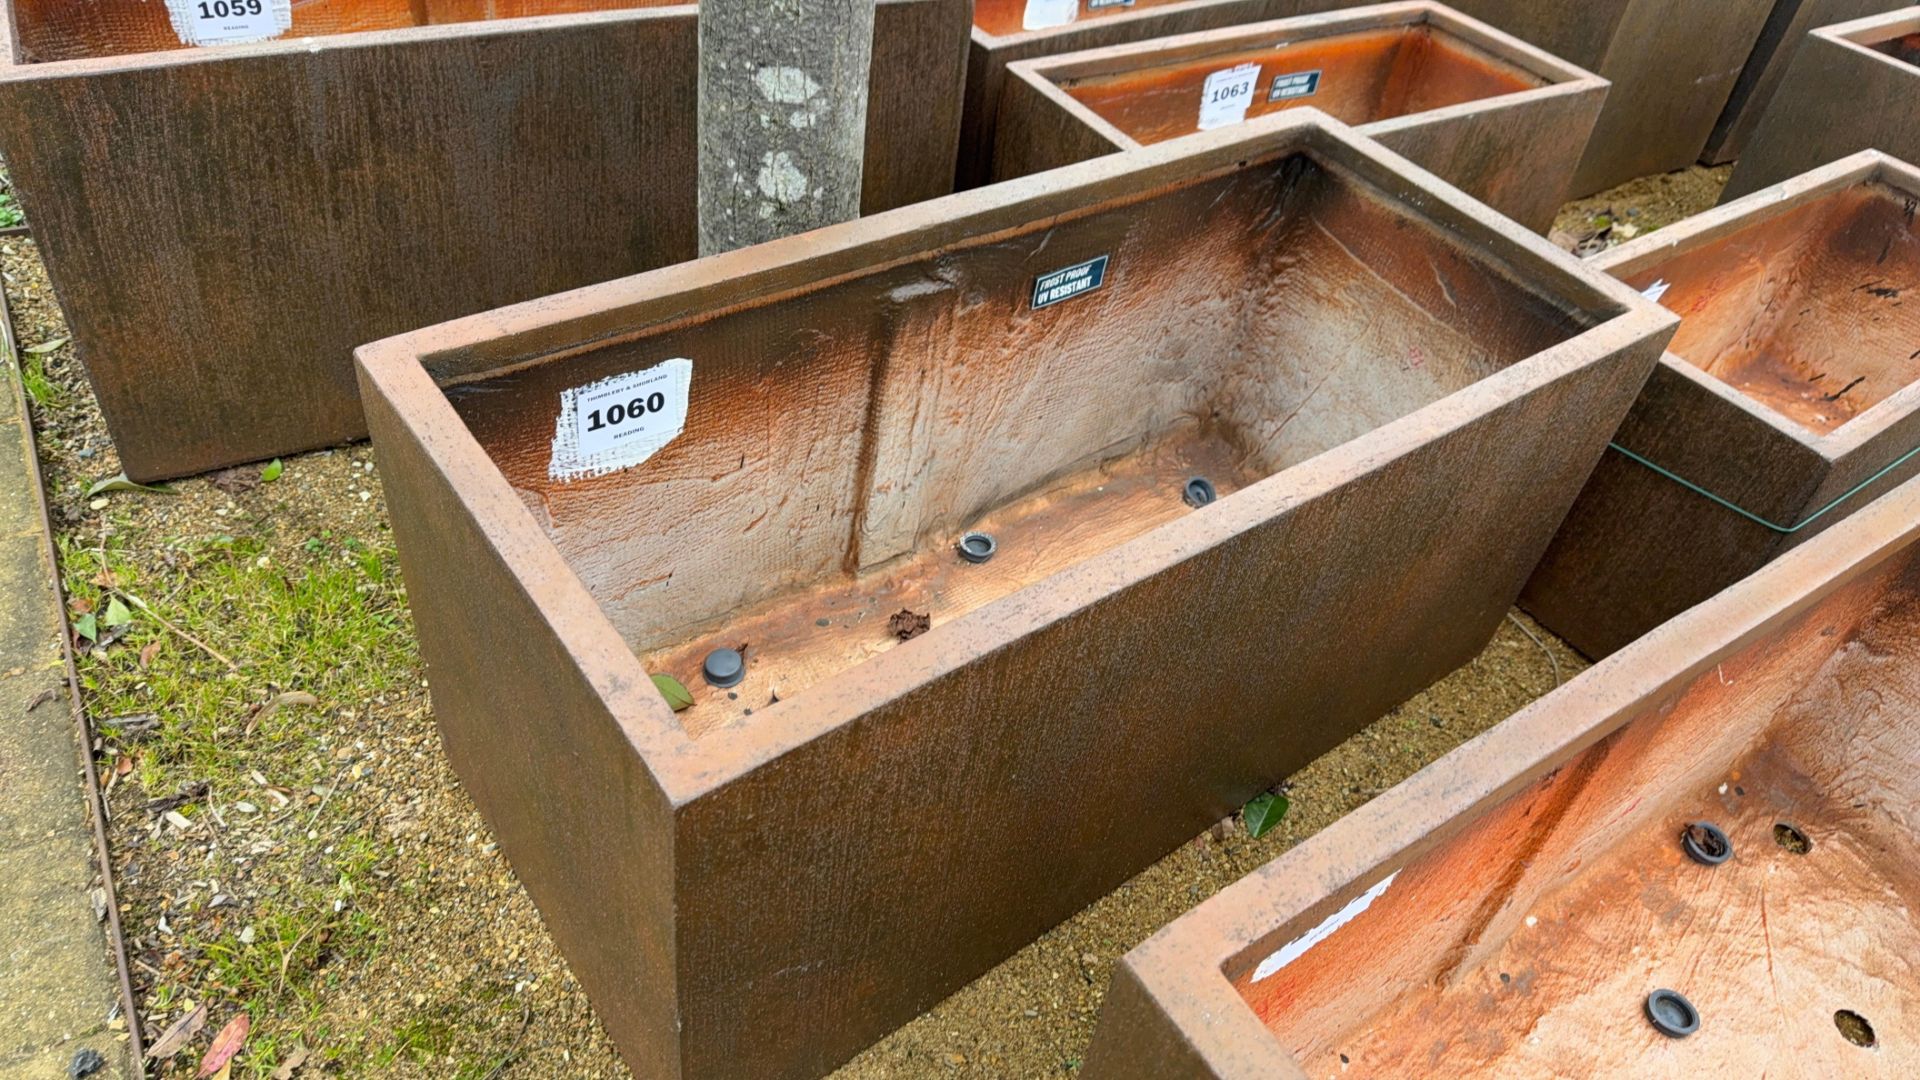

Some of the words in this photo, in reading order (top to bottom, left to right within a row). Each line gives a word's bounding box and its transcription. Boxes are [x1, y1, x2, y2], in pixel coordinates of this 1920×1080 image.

[198, 0, 262, 19] 1059
[1211, 81, 1249, 103] 1063
[1040, 273, 1065, 291] FROST
[1065, 264, 1092, 282] PROOF
[1038, 290, 1049, 305] UV
[1049, 276, 1092, 300] RESISTANT
[587, 388, 624, 402] THIMBLEBY
[588, 392, 665, 432] 1060
[613, 426, 645, 439] READING
